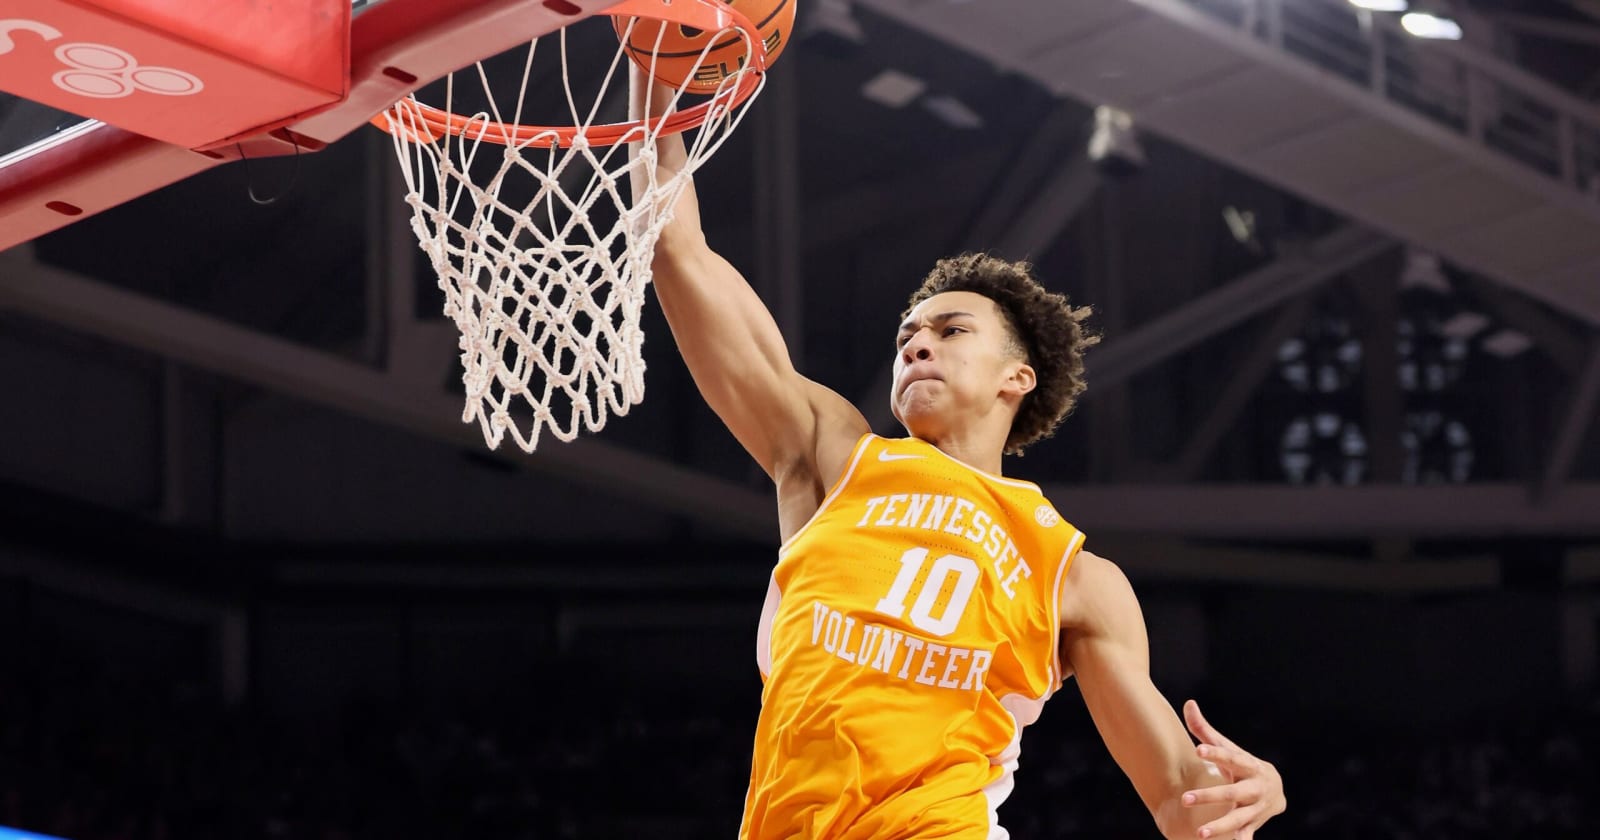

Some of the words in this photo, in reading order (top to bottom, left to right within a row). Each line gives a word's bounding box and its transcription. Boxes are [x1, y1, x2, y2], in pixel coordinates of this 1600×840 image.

[856, 494, 1032, 600] TENNESSEE
[1036, 506, 1058, 526] SEC
[875, 547, 980, 637] 10
[811, 601, 992, 691] VOLUNTEER
